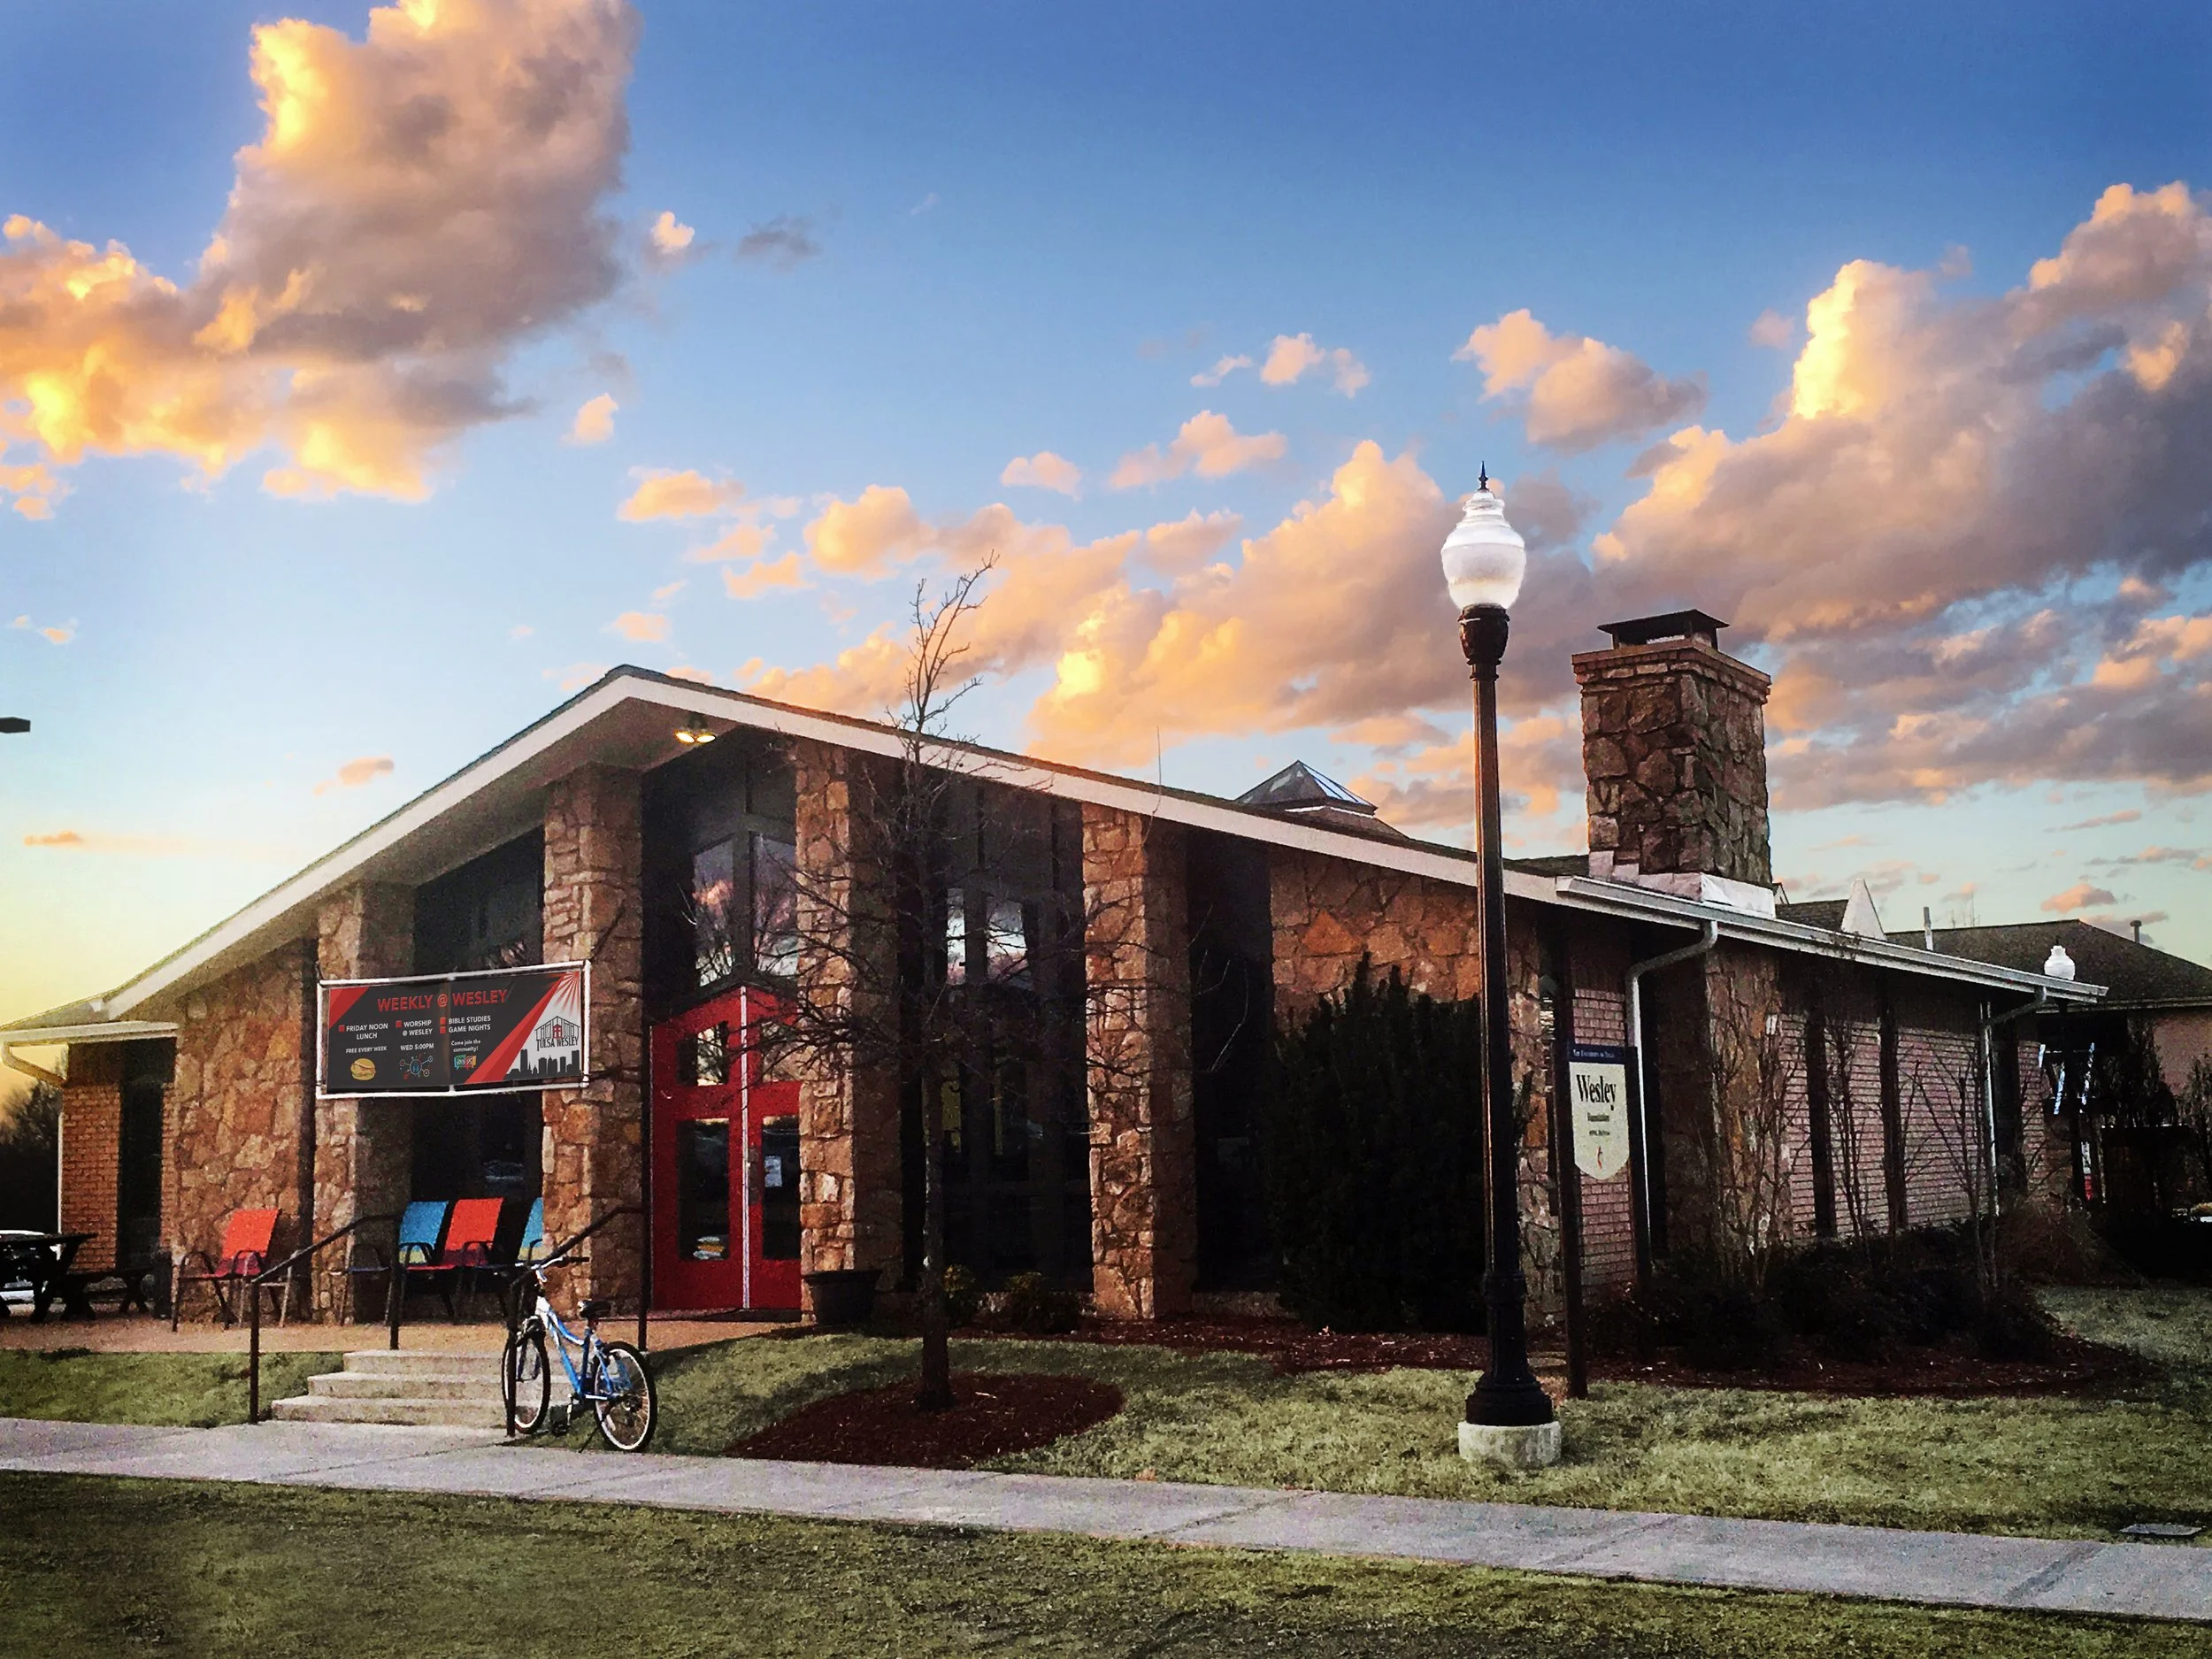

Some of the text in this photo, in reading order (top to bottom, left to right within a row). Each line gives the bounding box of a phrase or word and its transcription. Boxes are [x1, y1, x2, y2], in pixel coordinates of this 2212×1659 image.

[377, 989, 508, 1012] WEEKLY @ WESLEY
[535, 1036, 580, 1052] TULSA WESLEY
[1576, 1074, 1617, 1111] Wesley
